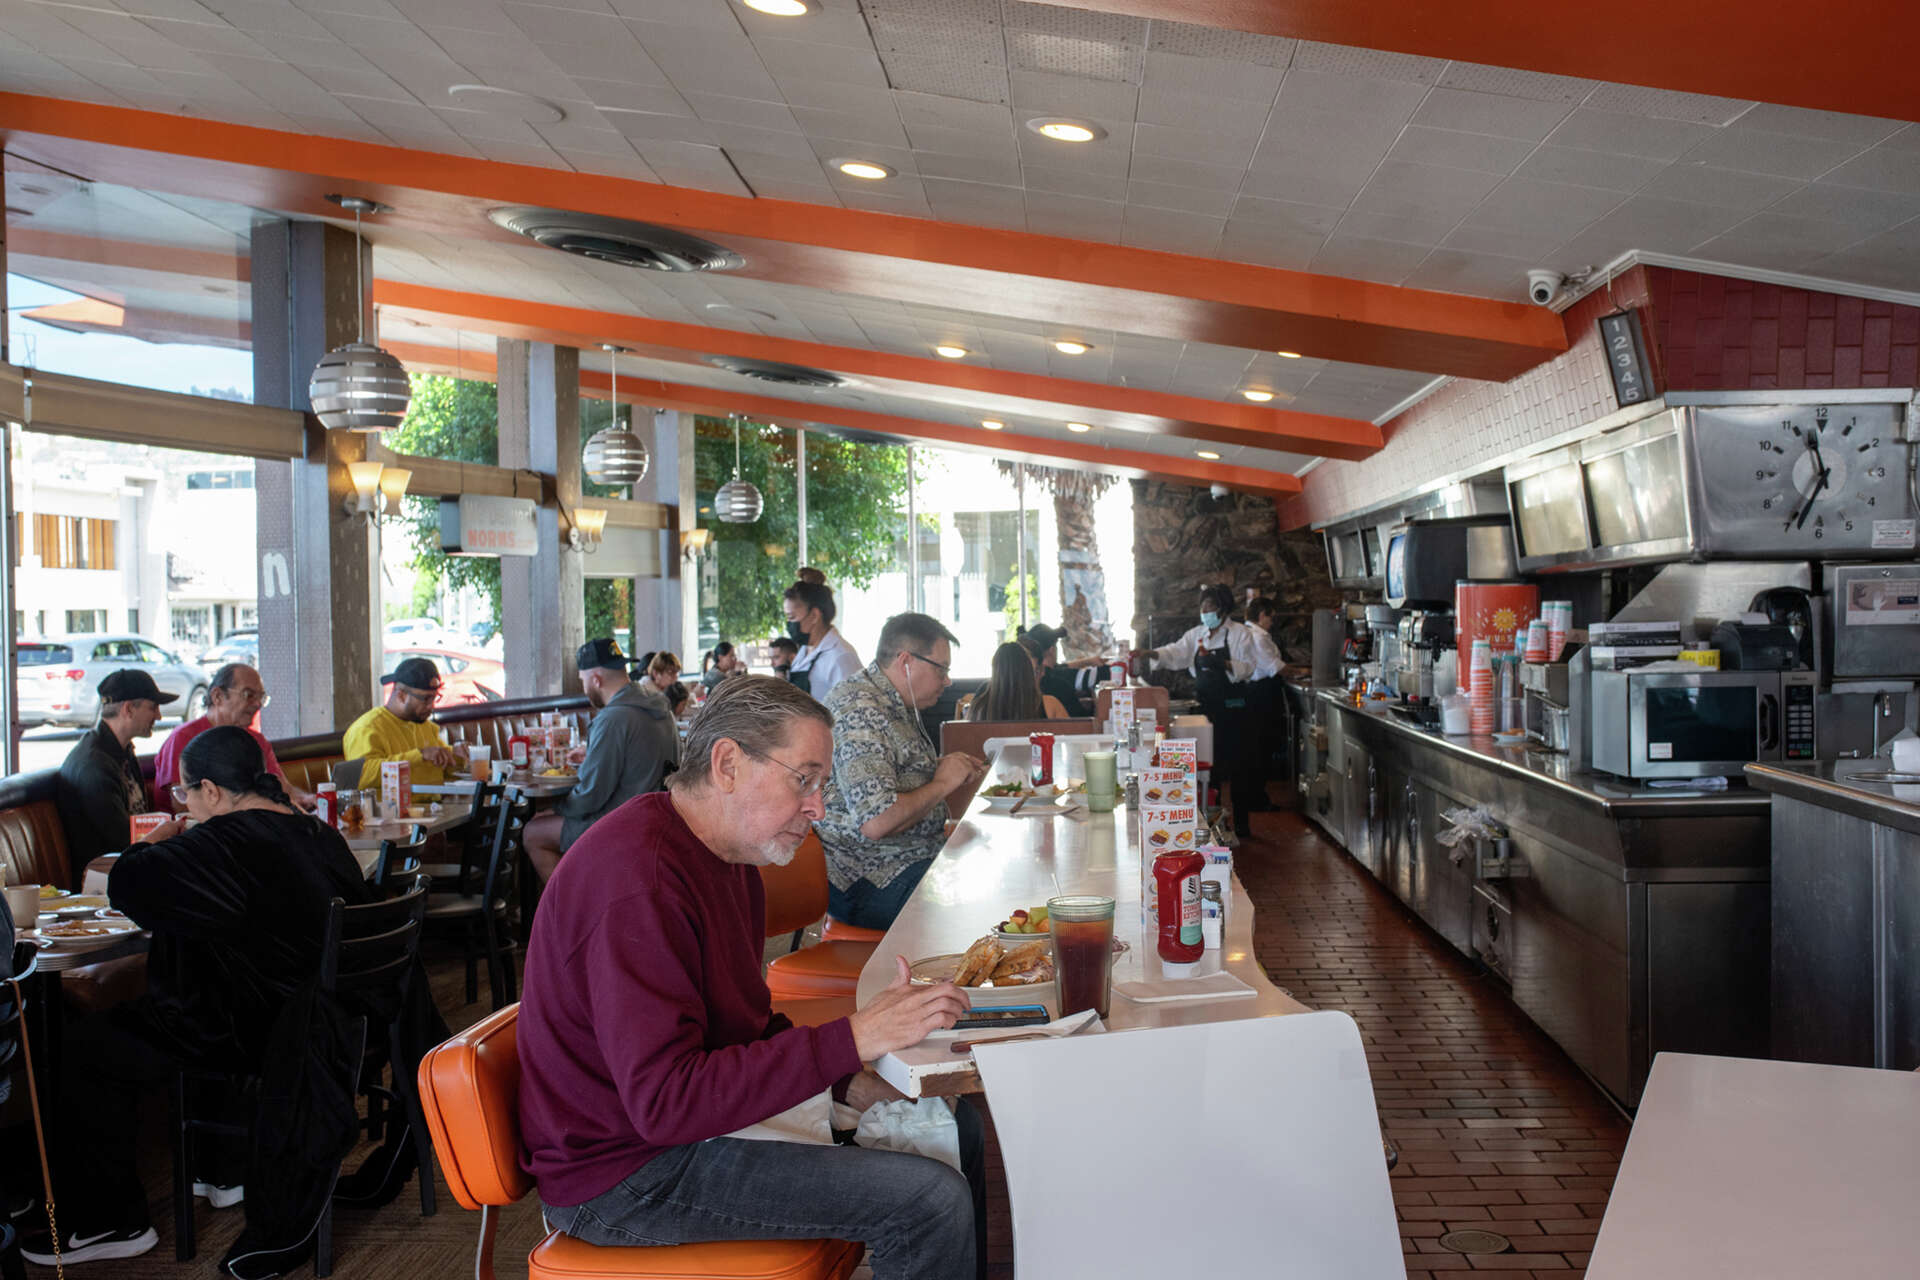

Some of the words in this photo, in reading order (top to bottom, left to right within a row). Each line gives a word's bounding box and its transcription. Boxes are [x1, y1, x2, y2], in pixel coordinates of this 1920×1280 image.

[1815, 408, 1828, 417] 12
[1782, 420, 1791, 430] 11
[1759, 441, 1771, 450] 10
[1872, 438, 1880, 447] 2
[1756, 470, 1764, 480] 9
[1877, 467, 1885, 477] 3
[1763, 499, 1771, 509] 8
[1867, 497, 1875, 506] 4
[1783, 522, 1791, 533] 7
[1845, 521, 1853, 530] 5
[467, 529, 516, 548] NORMS
[1815, 529, 1823, 539] 6
[1169, 808, 1194, 821] MENU
